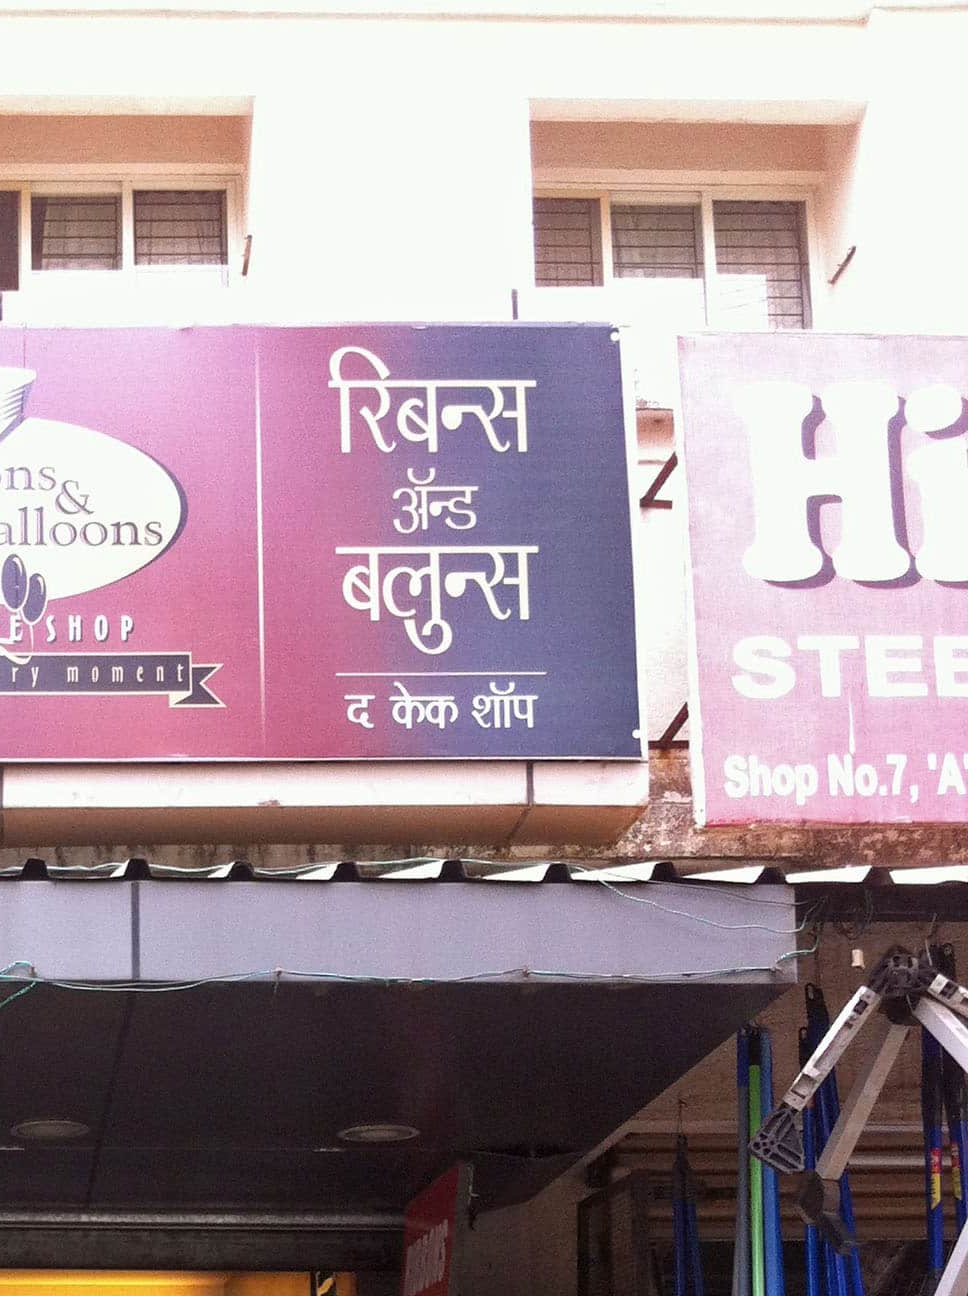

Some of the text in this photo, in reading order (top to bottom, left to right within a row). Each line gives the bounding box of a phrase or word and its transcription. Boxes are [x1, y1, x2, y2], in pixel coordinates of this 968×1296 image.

[328, 346, 537, 453] रिबन्स
[54, 479, 94, 516] &
[46, 615, 135, 642] SHOP
[66, 662, 186, 685] moment
[344, 682, 539, 729] द केक शॉप
[724, 754, 818, 805] Shop
